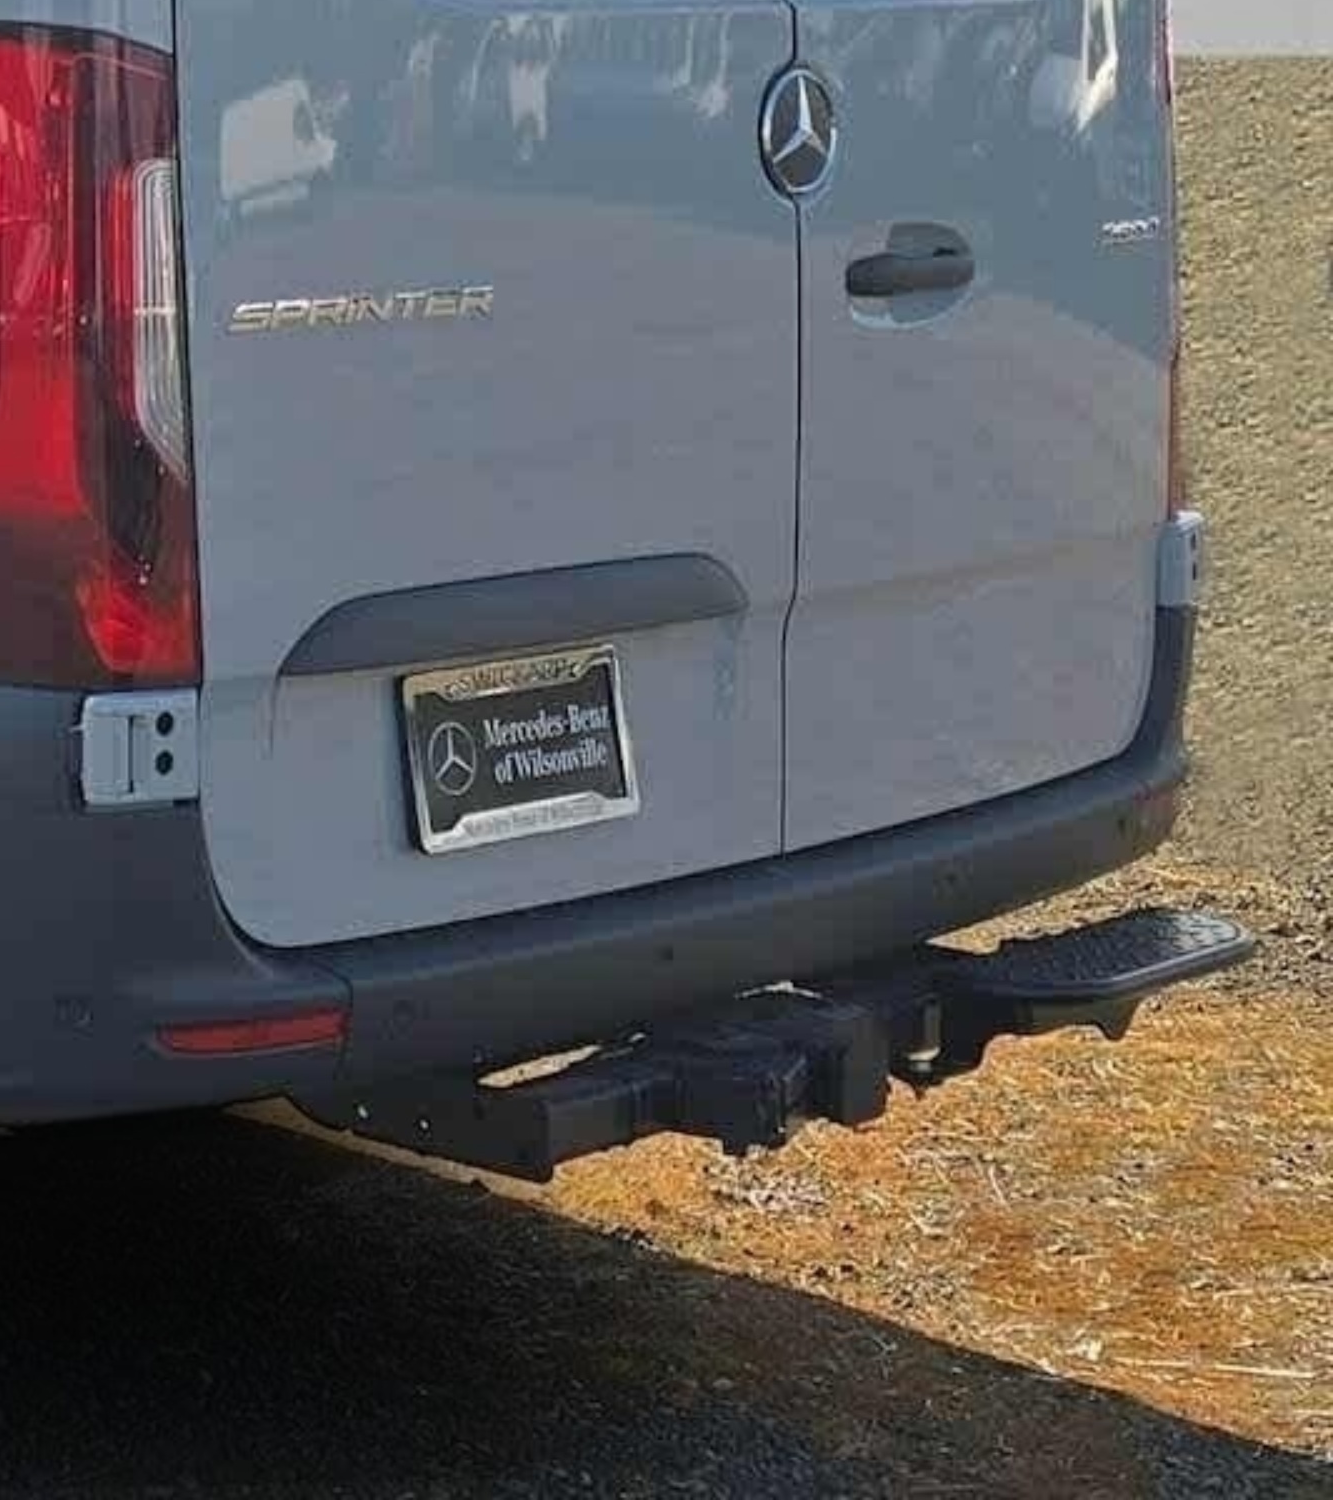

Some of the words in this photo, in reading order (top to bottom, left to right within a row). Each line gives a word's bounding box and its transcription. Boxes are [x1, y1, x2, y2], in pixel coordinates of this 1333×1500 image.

[229, 285, 494, 332] SPRINTER
[483, 704, 610, 748] Mercedes-Benz
[495, 752, 513, 783] of
[514, 737, 608, 778] Wilsonville
